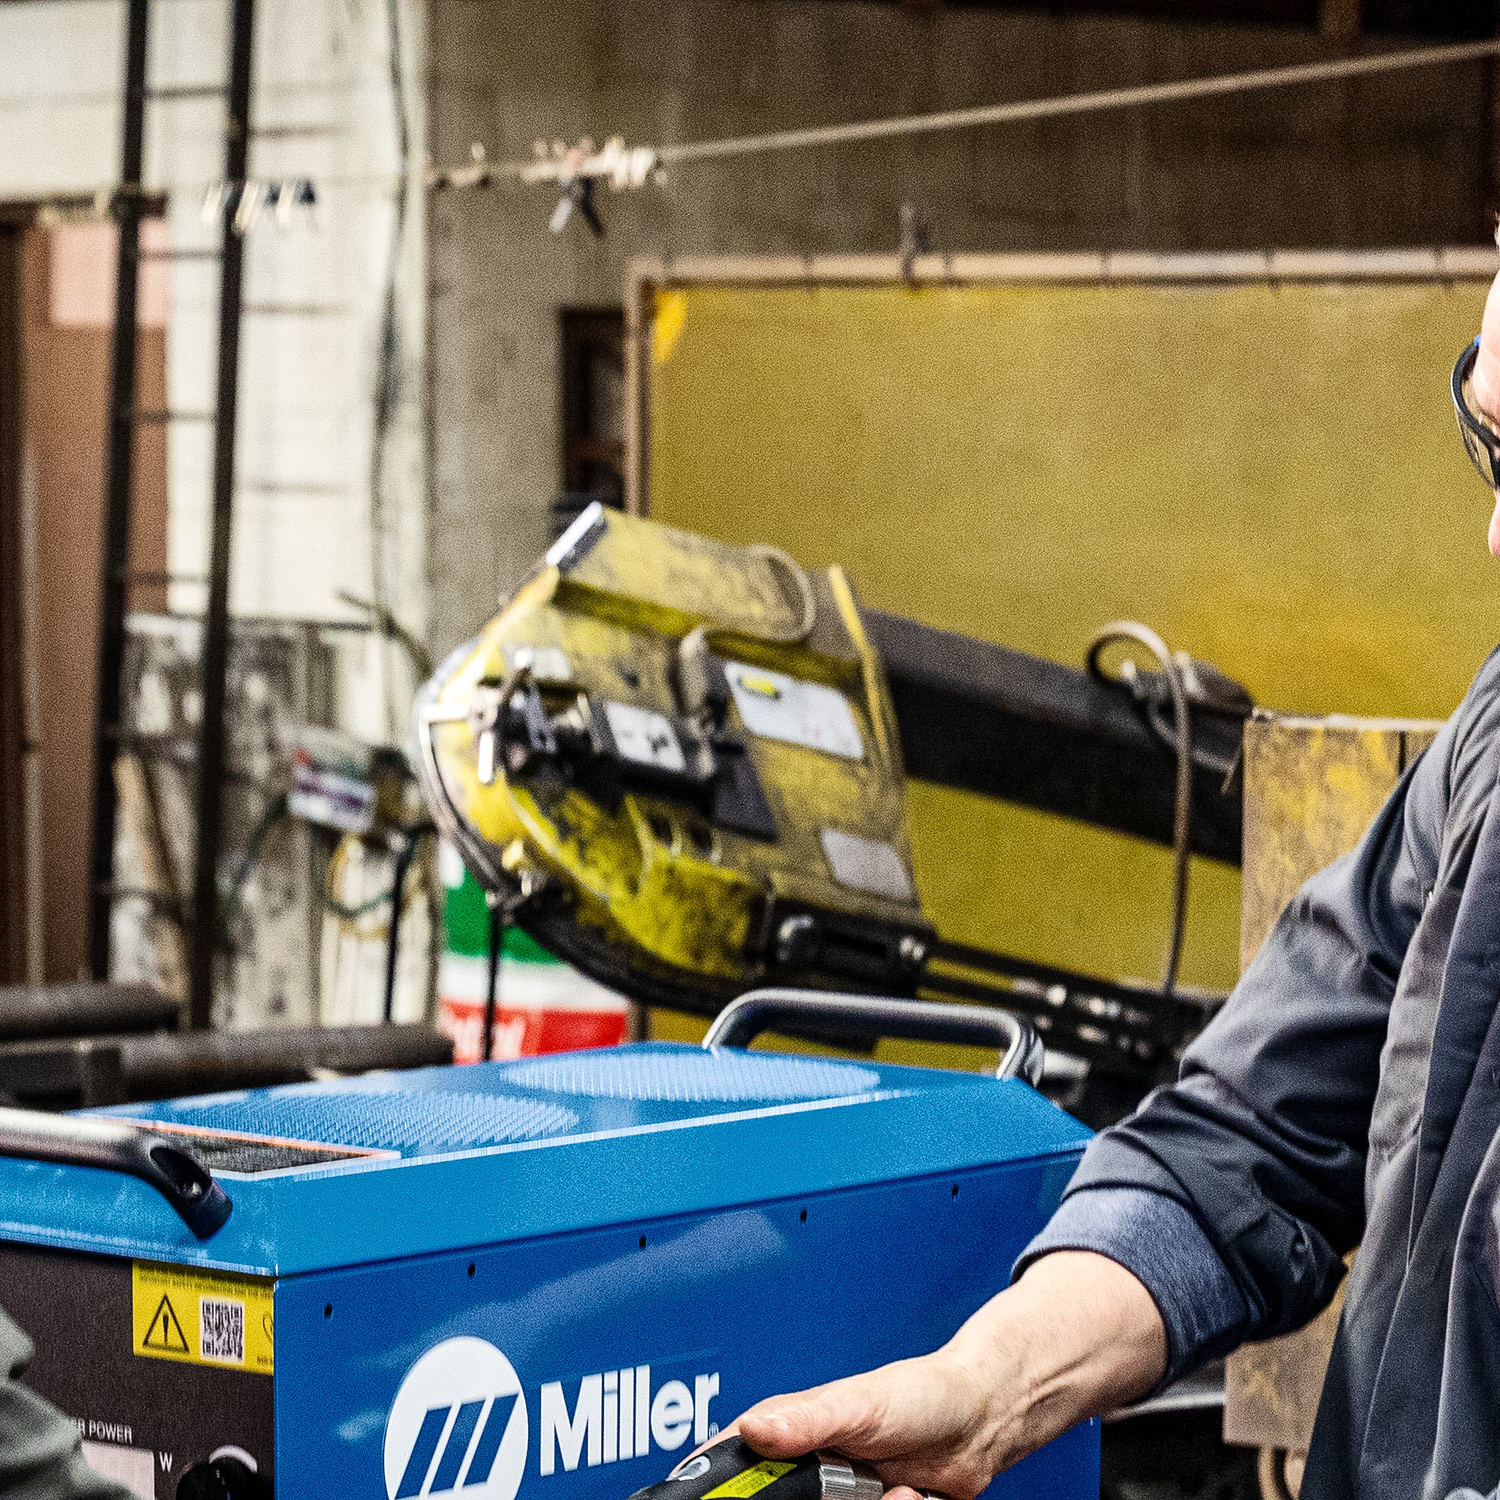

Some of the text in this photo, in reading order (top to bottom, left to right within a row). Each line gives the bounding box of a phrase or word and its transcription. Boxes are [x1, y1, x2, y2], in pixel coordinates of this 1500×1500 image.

[89, 1420, 133, 1444] POWER
[540, 1364, 719, 1477] Miller
[159, 1451, 173, 1473] W
